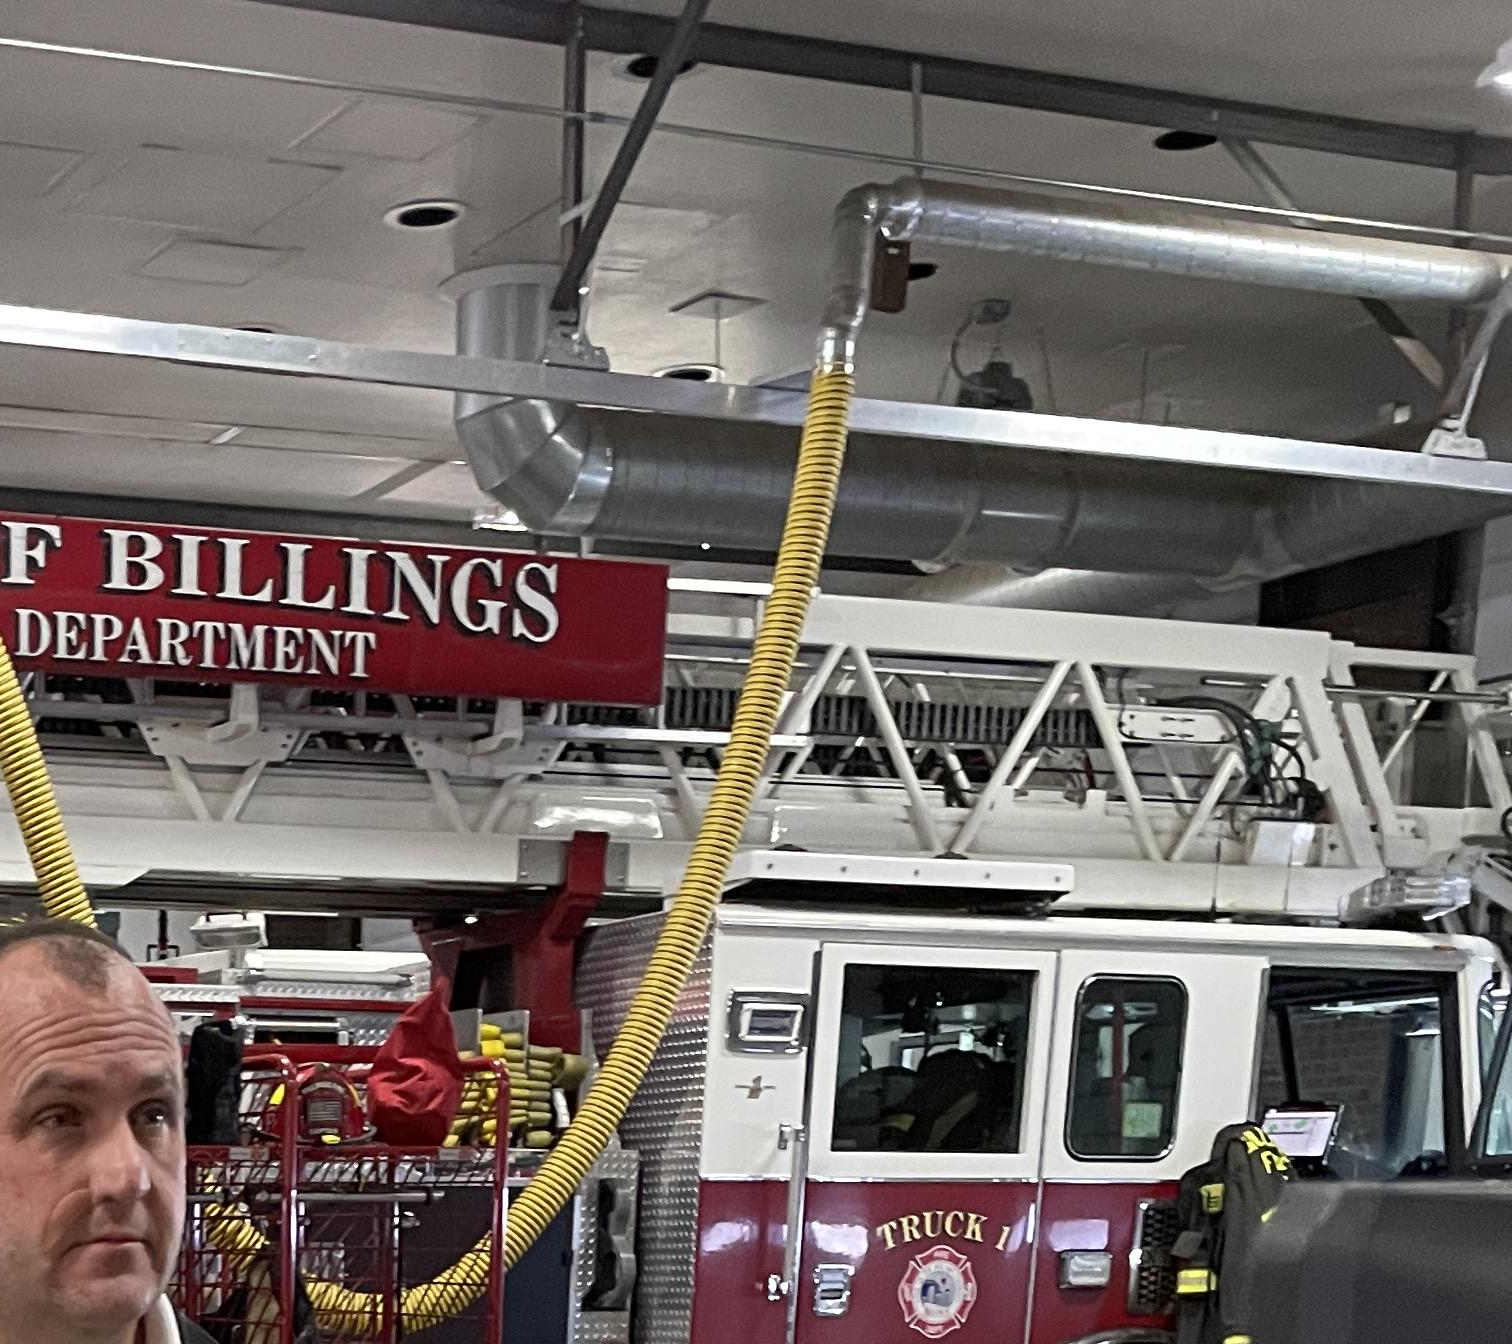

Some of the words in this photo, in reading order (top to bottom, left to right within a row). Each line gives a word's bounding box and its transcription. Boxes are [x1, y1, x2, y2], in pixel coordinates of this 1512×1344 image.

[102, 528, 560, 644] BILLINGS
[15, 608, 376, 678] DEPARTMENT
[876, 1210, 988, 1251] TRUCK
